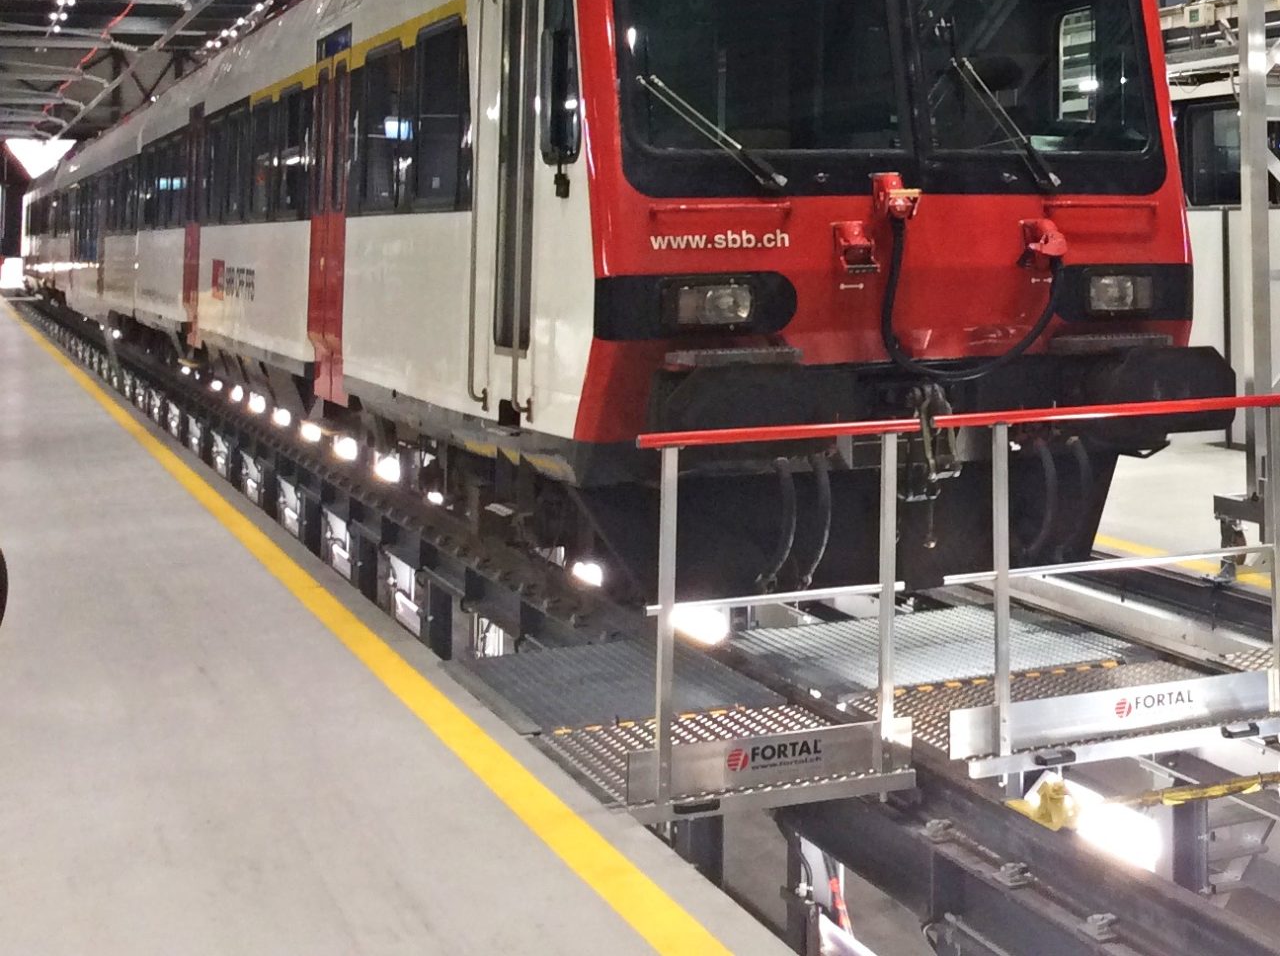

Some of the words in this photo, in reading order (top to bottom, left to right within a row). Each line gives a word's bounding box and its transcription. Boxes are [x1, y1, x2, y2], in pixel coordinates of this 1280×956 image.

[650, 229, 790, 250] www.sbb.ch
[1135, 690, 1194, 710] FORTAL
[751, 739, 822, 762] FORTAL
